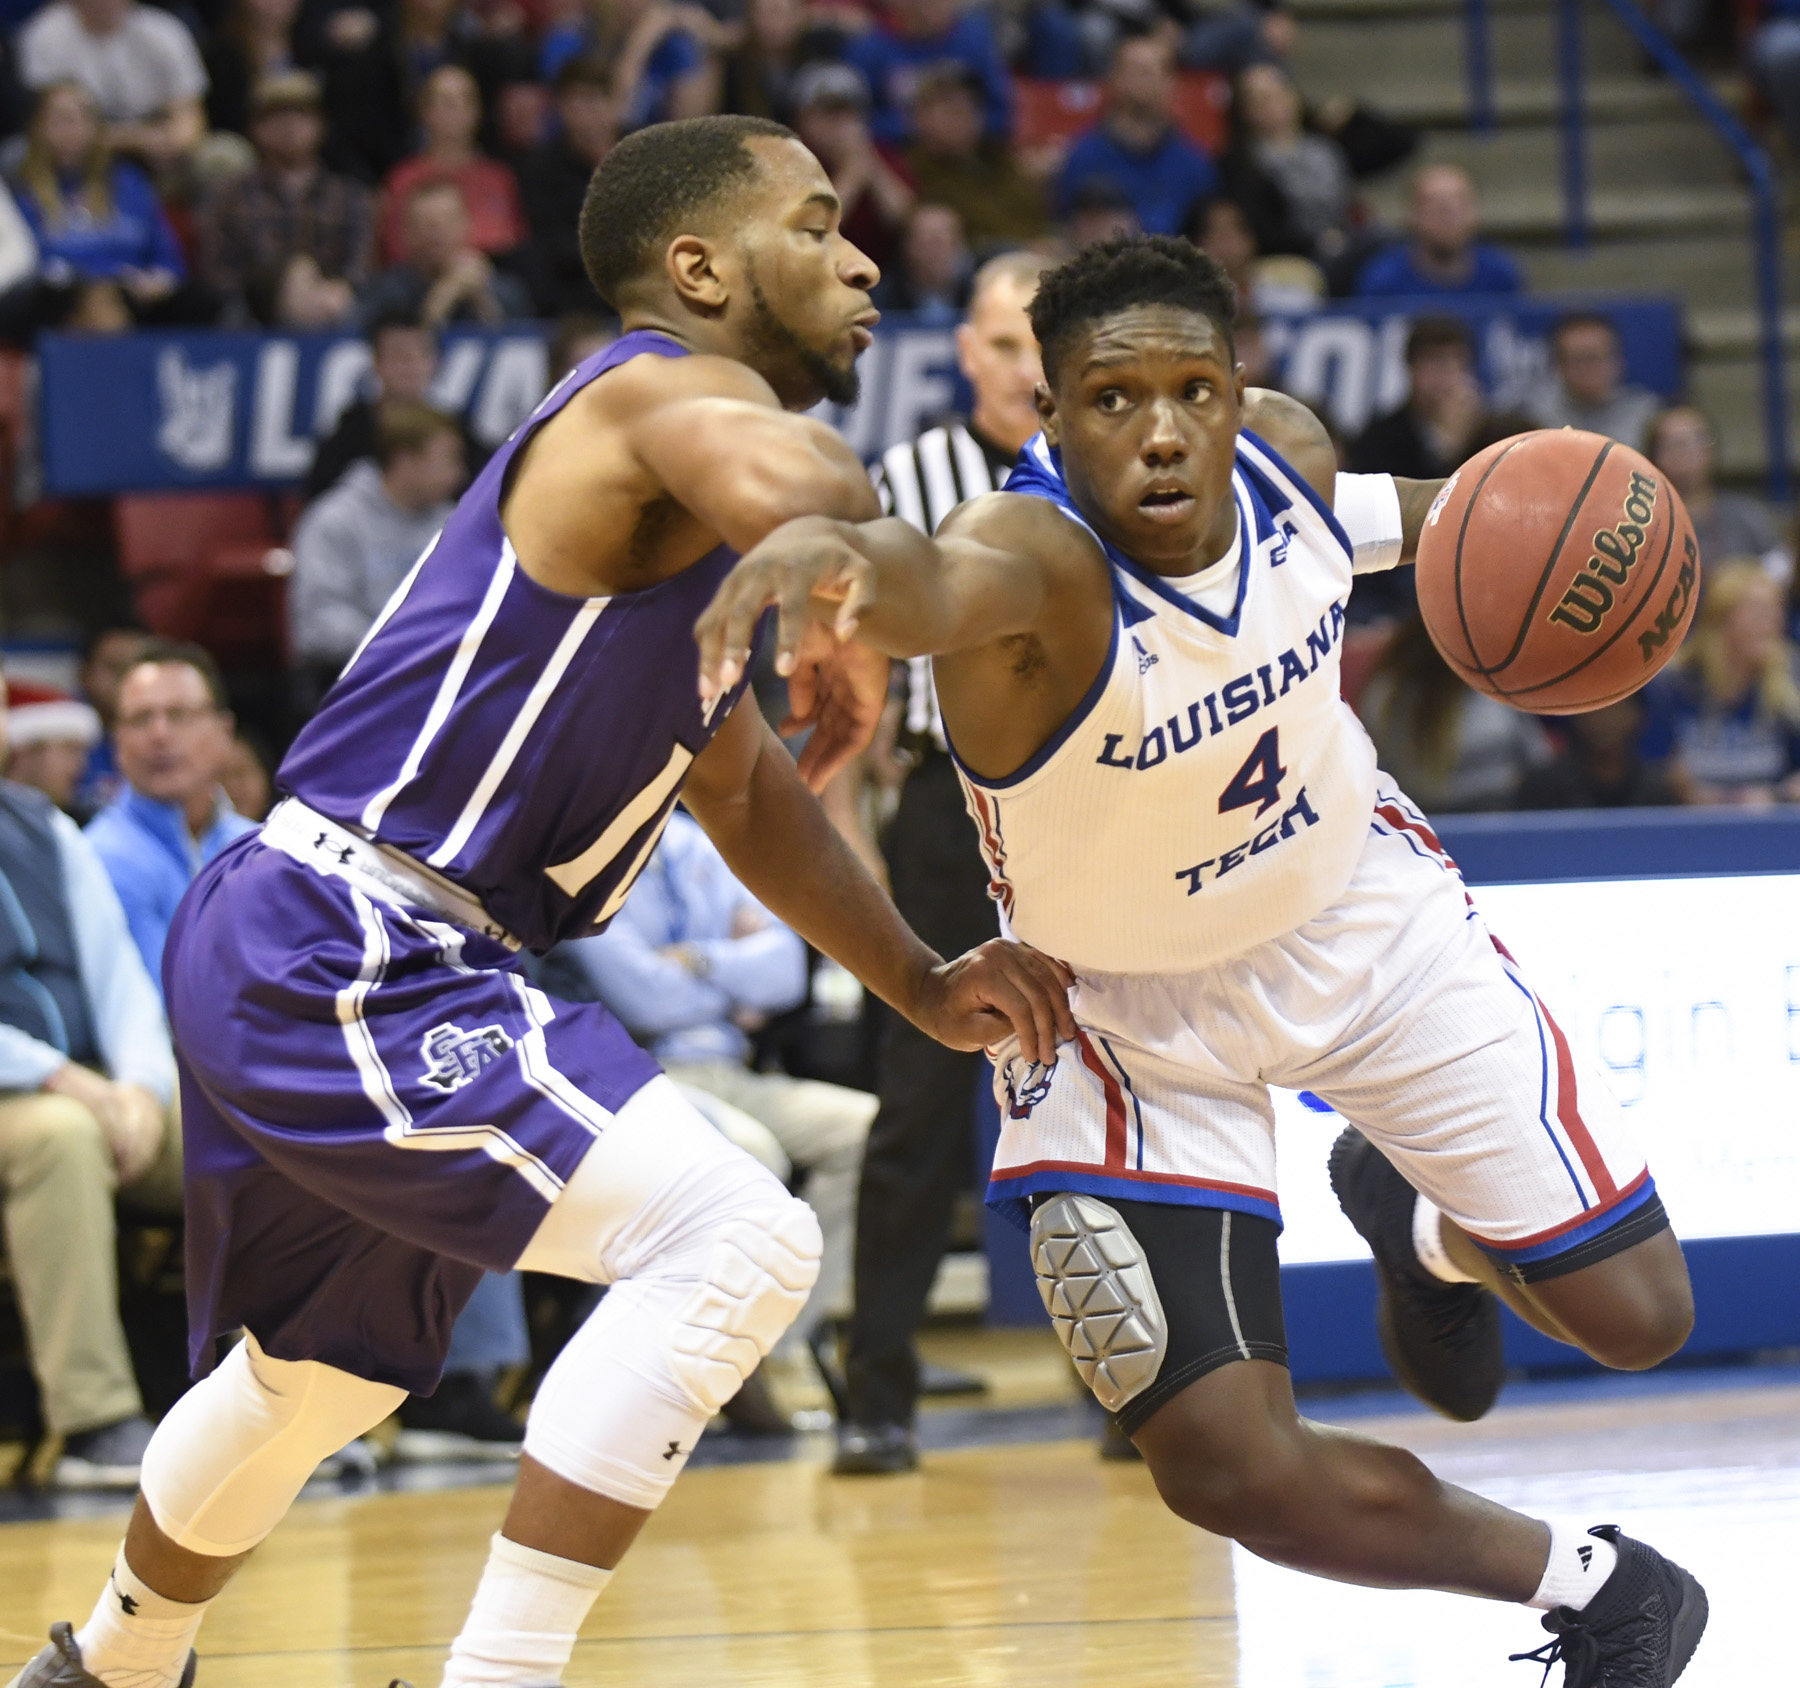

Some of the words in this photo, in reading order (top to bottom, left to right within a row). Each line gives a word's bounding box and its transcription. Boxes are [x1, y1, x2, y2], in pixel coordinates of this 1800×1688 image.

[1546, 469, 1658, 636] Wilson
[1638, 533, 1699, 664] NCAA
[1096, 597, 1344, 770] LOUISIANA
[1218, 725, 1288, 821] 4
[1175, 784, 1320, 896] TECH
